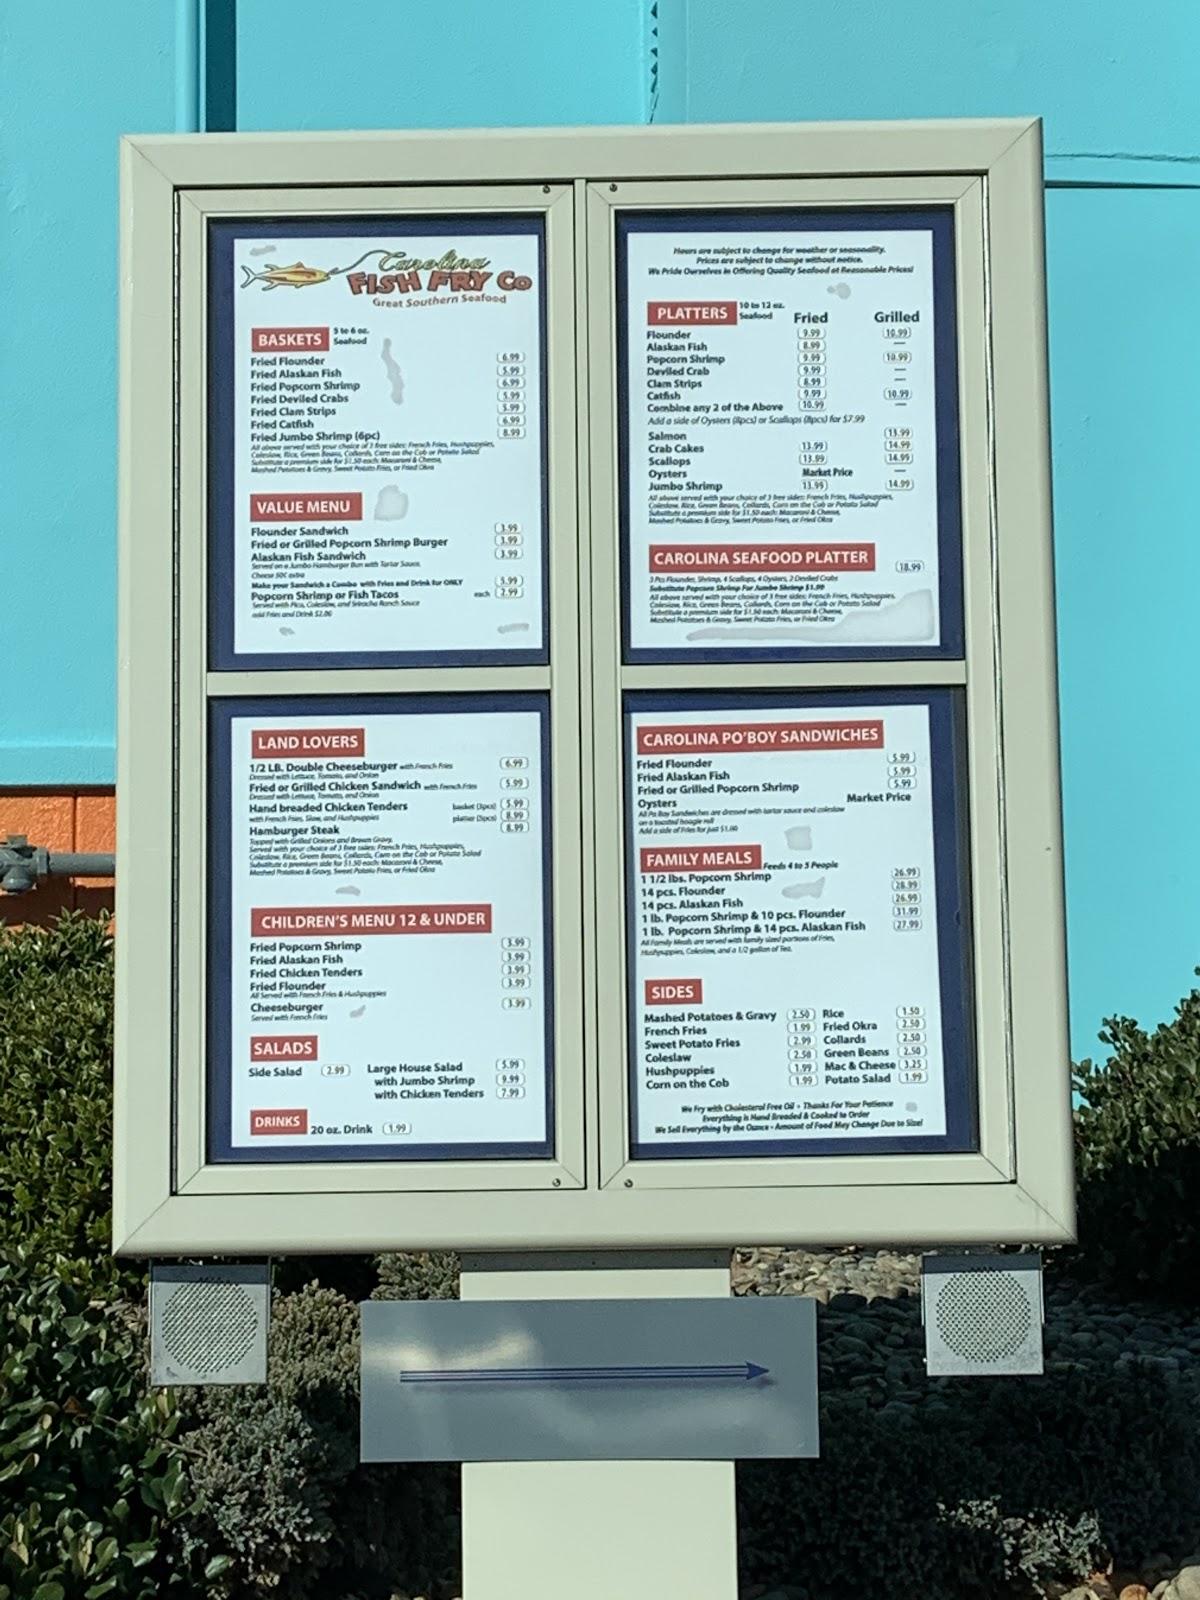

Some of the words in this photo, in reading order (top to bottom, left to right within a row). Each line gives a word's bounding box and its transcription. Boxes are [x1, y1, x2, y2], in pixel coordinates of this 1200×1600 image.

[379, 249, 491, 271] Carolina
[346, 271, 422, 295] FISH
[427, 271, 493, 291] FRY
[497, 271, 532, 290] Co
[373, 297, 405, 308] Great
[406, 296, 458, 307] Southern
[462, 293, 506, 304] Seafood
[657, 306, 727, 319] PLATTERS
[793, 312, 828, 323] Fried
[873, 310, 919, 323] Grilled
[258, 332, 321, 346] BASKETS
[646, 328, 691, 339] Flounder
[646, 341, 685, 352] Alaskan
[687, 341, 707, 351] Fish
[250, 356, 276, 366] Fried
[278, 355, 325, 366] Flounder
[646, 353, 688, 366] Popcorn
[689, 353, 725, 366] Shrimp
[250, 368, 276, 379] Fried
[278, 367, 319, 378] Alaskan
[321, 367, 341, 377] Fish
[646, 366, 684, 376] Deviled
[686, 365, 710, 376] Crab
[250, 381, 276, 392] Fried
[278, 380, 321, 394] Popcorn
[323, 379, 360, 393] Shrimp
[646, 378, 672, 388] Clam
[673, 377, 702, 391] Strips
[646, 390, 681, 400] Catfish
[250, 406, 276, 417] Fried
[278, 406, 304, 416] Clam
[306, 405, 336, 418] Strips
[646, 402, 691, 413] Combine
[692, 404, 711, 415] any
[712, 402, 719, 412] 2
[720, 401, 731, 412] of
[733, 401, 750, 412] the
[751, 401, 783, 411] Above
[250, 419, 277, 429] Fried
[278, 418, 314, 429] Catfish
[250, 431, 277, 442] Fried
[278, 431, 313, 442] Jumbo
[315, 430, 352, 443] Shrimp
[354, 430, 380, 443] (6pc)
[648, 430, 687, 441] Salmon
[647, 443, 672, 453] Crab
[673, 442, 704, 453] Cakes
[648, 455, 691, 468] Scallops
[648, 468, 687, 481] Oysters
[648, 480, 684, 491] Jumbo
[685, 480, 723, 493] Shrimp
[256, 500, 303, 514] VALUE
[306, 499, 350, 513] MENU
[250, 526, 297, 536] Flounder
[299, 525, 349, 536] Sandwich
[250, 551, 292, 561] Alaskan
[293, 551, 314, 561] Fish
[316, 550, 366, 561] Sandwich
[654, 551, 729, 564] CAROLINA
[732, 550, 802, 564] SEAFOOD
[805, 550, 868, 563] PLATTER
[258, 736, 299, 749] LAND
[302, 735, 358, 748] LOVERS
[643, 731, 719, 746] CAROLINA
[722, 730, 777, 744] PO'BOY
[780, 727, 878, 742] SANDWICHES
[249, 762, 265, 772] 1/2
[267, 762, 284, 772] LB.
[285, 761, 324, 772] Double
[325, 760, 398, 774] Cheeseburger
[846, 791, 883, 802] Market
[885, 791, 911, 802] Price
[249, 802, 277, 813] Hand
[279, 802, 322, 812] breaded
[324, 801, 365, 812] Chicken
[366, 801, 408, 811] Tenders
[637, 797, 677, 811] Oysters
[249, 824, 309, 838] Hamburger
[310, 824, 340, 835] Steak
[647, 852, 698, 866] FAMILY
[702, 851, 752, 865] MEALS
[641, 886, 654, 897] 14
[655, 888, 676, 899] pcs.
[678, 885, 725, 896] Flounder
[261, 914, 348, 928] CHILDREN'S
[351, 913, 395, 927] MENU
[399, 913, 416, 926] 12
[419, 913, 431, 925] &
[434, 912, 485, 925] UNDER
[249, 941, 276, 952] Fried
[278, 941, 322, 954] Popcorn
[324, 940, 362, 953] Shrimp
[249, 980, 277, 991] Fried
[278, 980, 326, 991] Flounder
[651, 985, 694, 998] SIDES
[250, 1001, 323, 1015] Cheeseburger
[822, 1008, 844, 1018] Rice
[643, 1011, 685, 1023] Mashed
[687, 1010, 733, 1022] Potatoes
[735, 1010, 743, 1021] &
[745, 1009, 776, 1023] Gravy
[644, 1025, 680, 1036] French
[682, 1024, 707, 1035] Fries
[823, 1020, 849, 1031] Fried
[851, 1020, 877, 1030] Okra
[644, 1038, 676, 1049] Sweet
[678, 1037, 713, 1048] Potato
[715, 1037, 740, 1048] Fries
[823, 1033, 866, 1044] Collards
[254, 1041, 312, 1055] SALADS
[823, 1047, 856, 1057] Green
[857, 1046, 889, 1057] Beans
[644, 1052, 691, 1063] Coleslaw
[248, 1066, 271, 1077] Side
[273, 1066, 302, 1077] Salad
[645, 1065, 715, 1078] Hushpuppies
[824, 1073, 860, 1084] Potato
[861, 1073, 891, 1083] Salad
[255, 1115, 300, 1127] DRINKS
[310, 1124, 324, 1135] 20
[325, 1126, 341, 1134] oz.
[343, 1123, 373, 1134] Drink
[389, 1124, 406, 1133] 1.99
